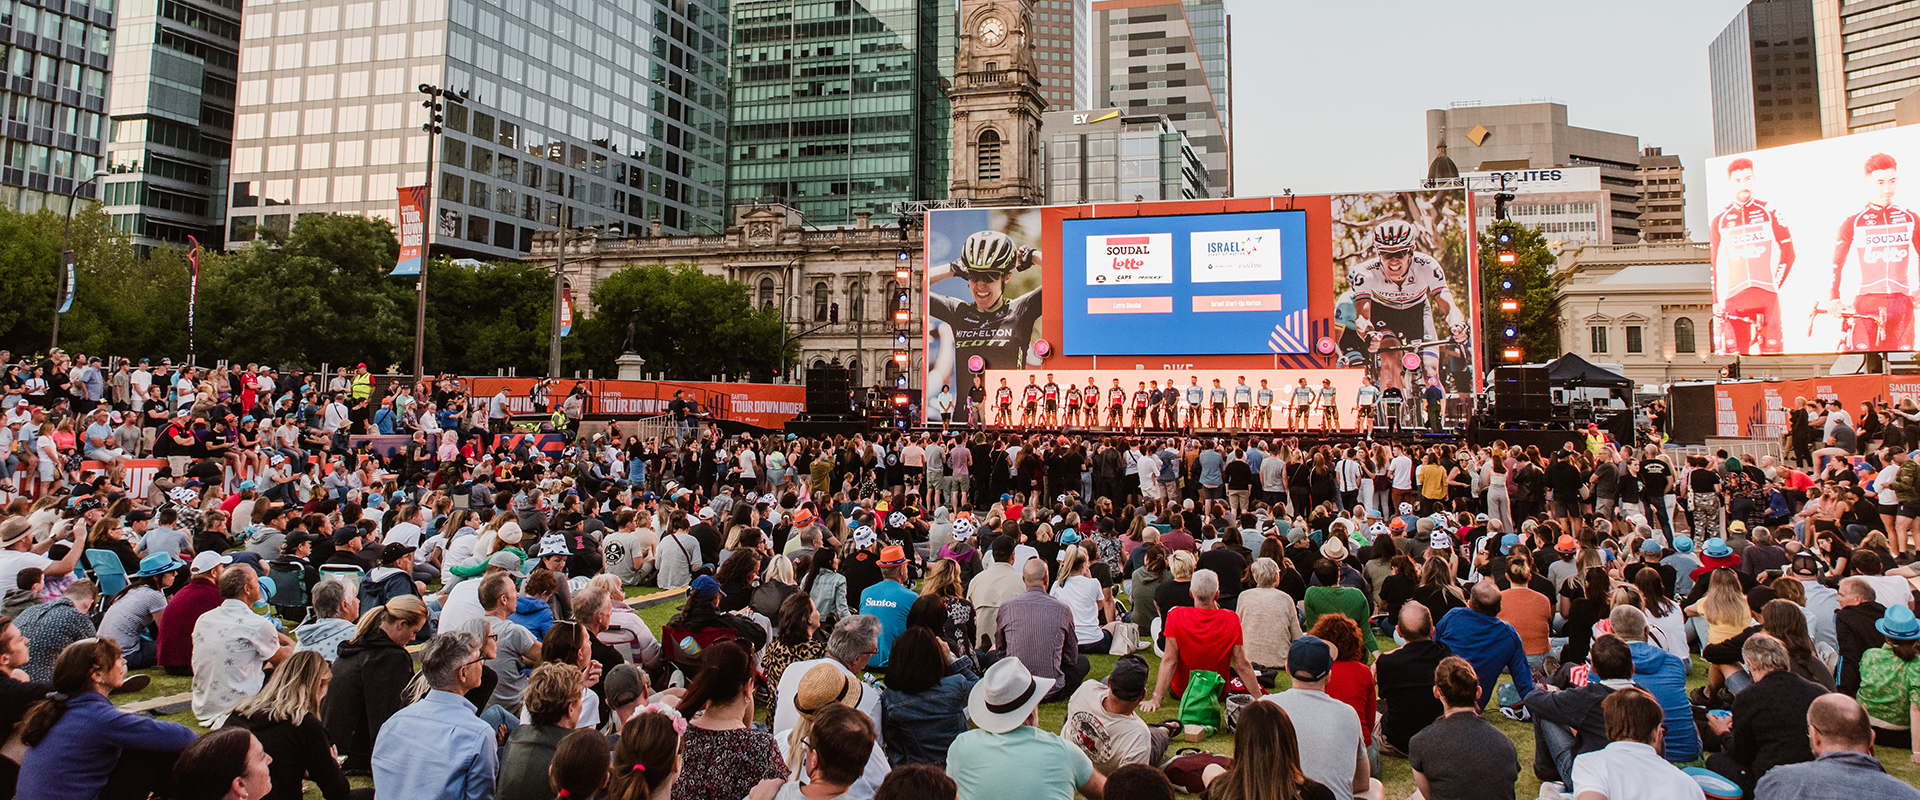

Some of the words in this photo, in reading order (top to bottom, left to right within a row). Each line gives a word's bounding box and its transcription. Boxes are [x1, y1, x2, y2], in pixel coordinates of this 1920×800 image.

[1073, 113, 1089, 125] EY
[401, 211, 420, 223] TOUR
[403, 222, 423, 235] DOWN
[403, 234, 422, 247] UNDE
[1865, 234, 1909, 244] SOUDAL
[1106, 246, 1150, 255] SOUDAL
[1207, 241, 1240, 252] ISRAEL
[956, 339, 1011, 348] SCOTT
[600, 399, 628, 413] TOUR
[731, 400, 753, 412] TOUR
[754, 400, 778, 413] DOWN
[779, 401, 804, 414] UNDER
[865, 597, 897, 608] Santos
